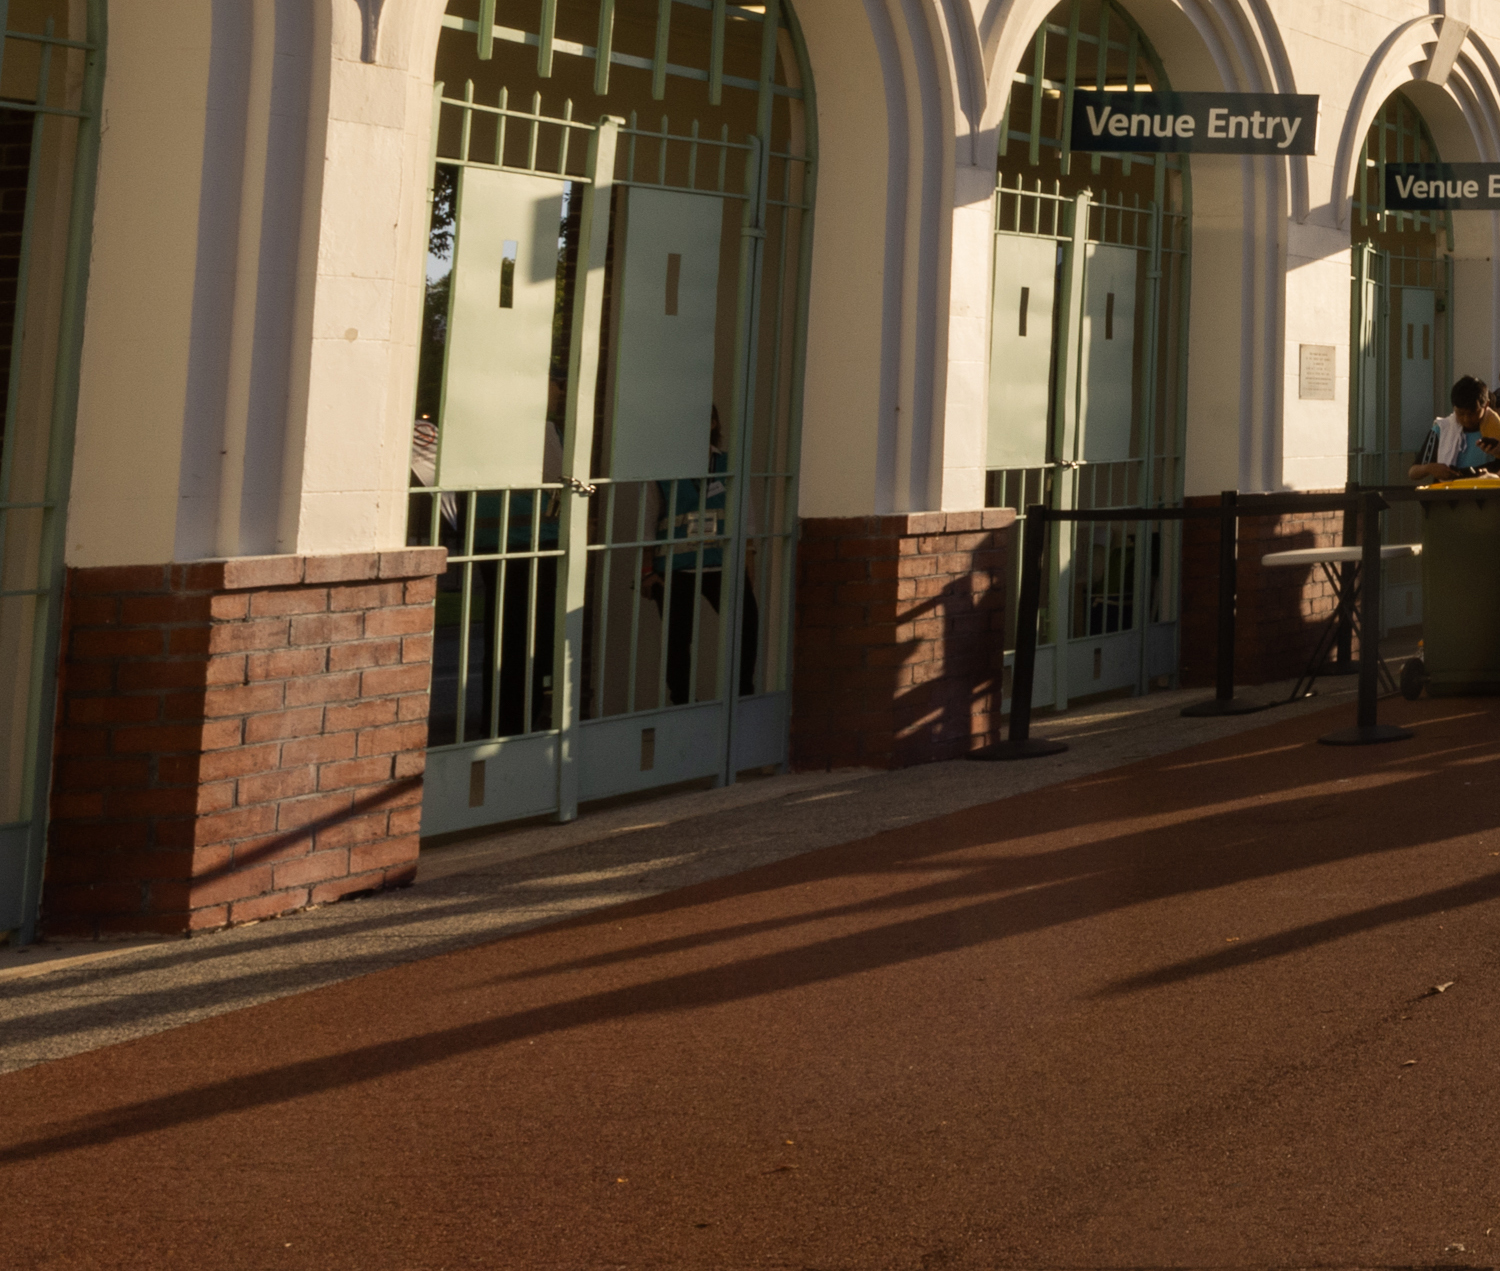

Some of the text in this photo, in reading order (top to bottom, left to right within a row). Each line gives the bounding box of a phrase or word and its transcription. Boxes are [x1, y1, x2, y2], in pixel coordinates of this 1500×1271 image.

[1085, 105, 1302, 149] Venue Entry
[1395, 175, 1480, 199] Venue
